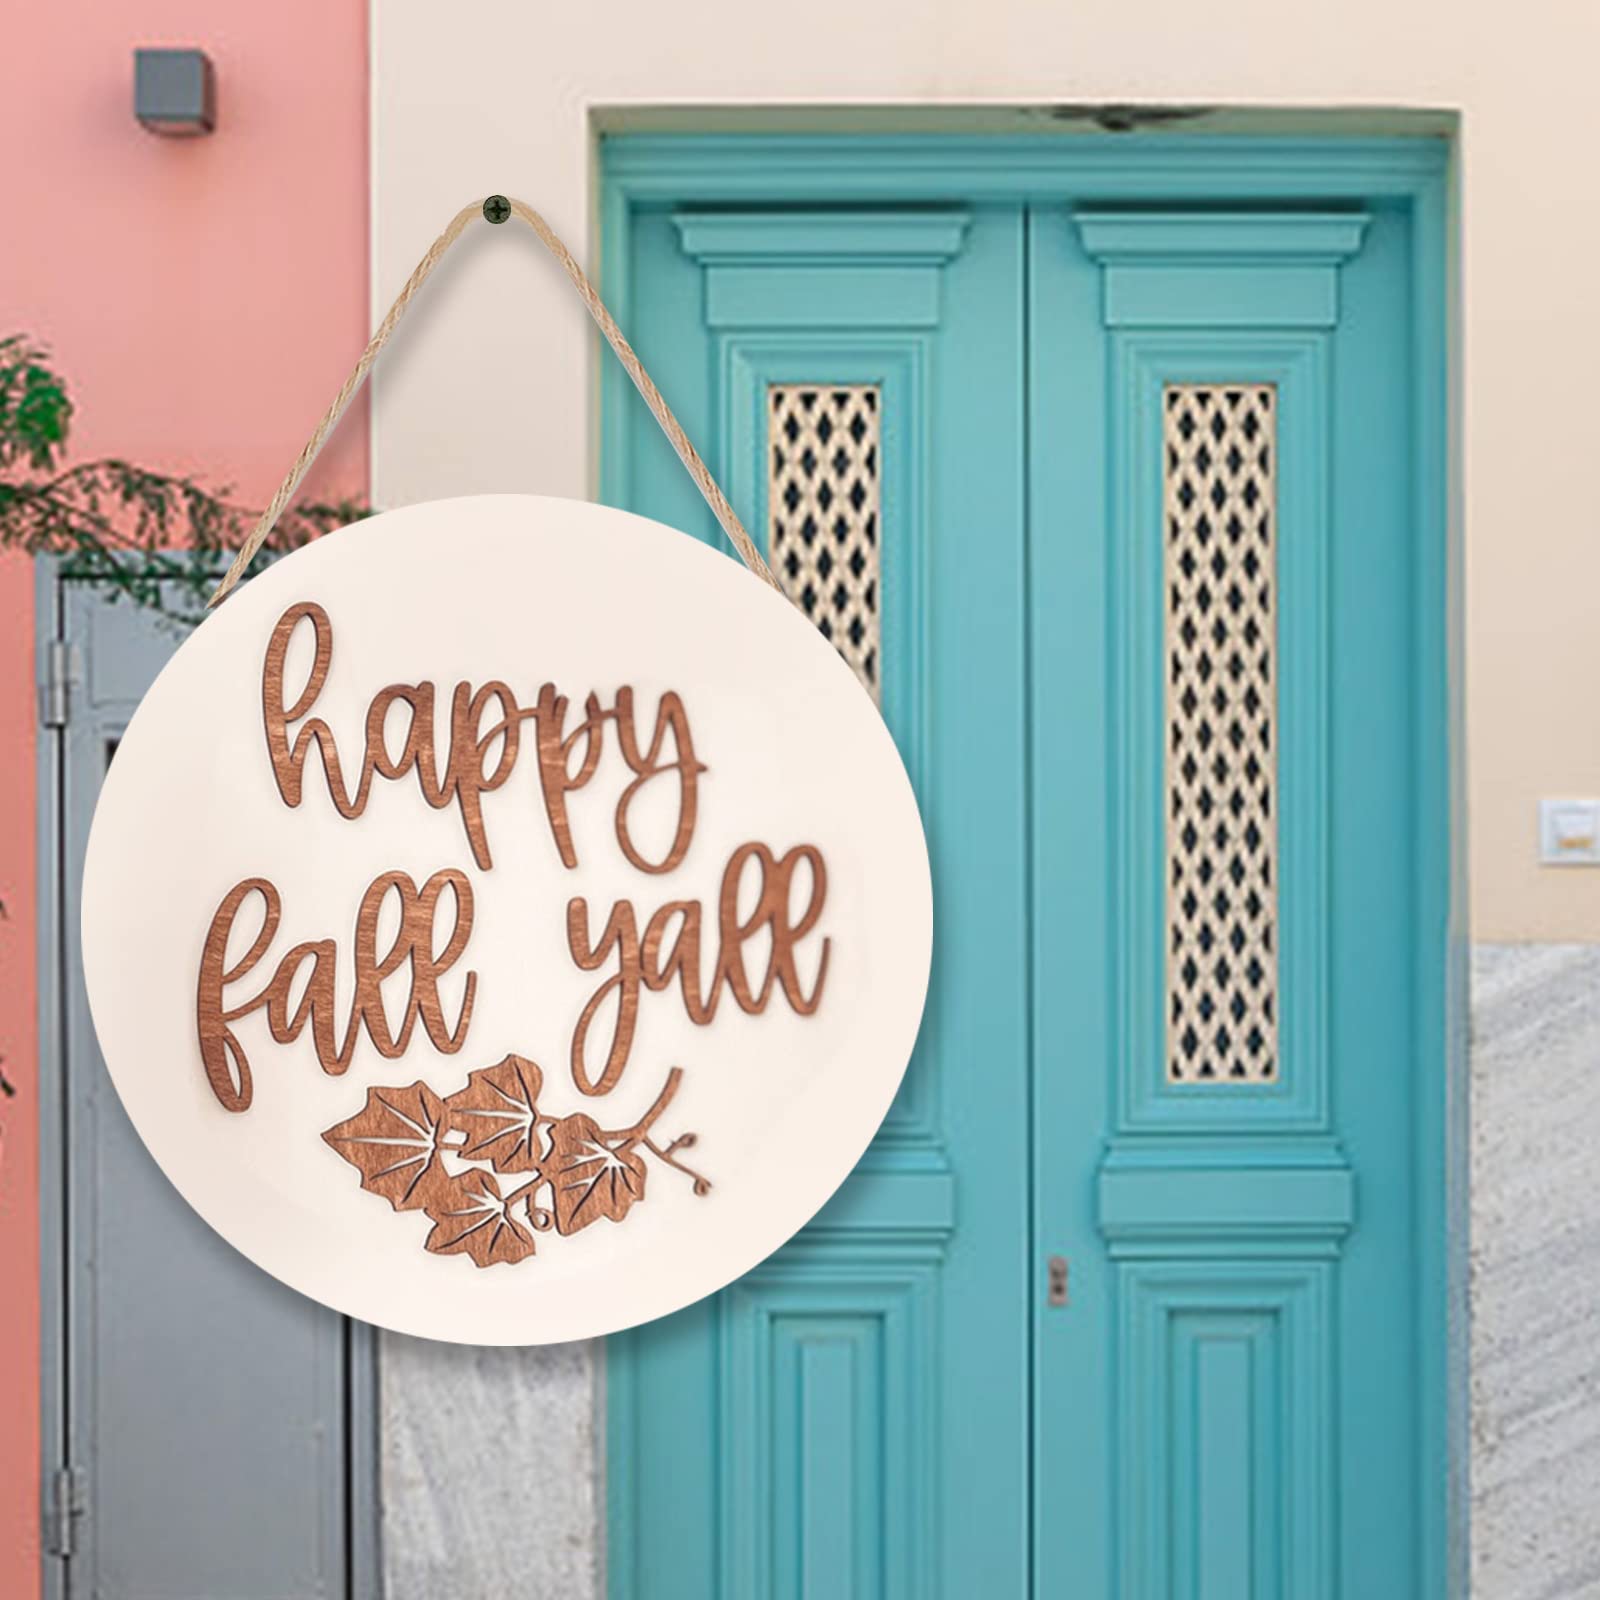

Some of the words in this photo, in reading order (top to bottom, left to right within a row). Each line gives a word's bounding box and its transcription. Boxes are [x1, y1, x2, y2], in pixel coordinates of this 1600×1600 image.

[262, 601, 708, 876] happy
[196, 868, 478, 1113] fall
[566, 841, 832, 1097] yall
